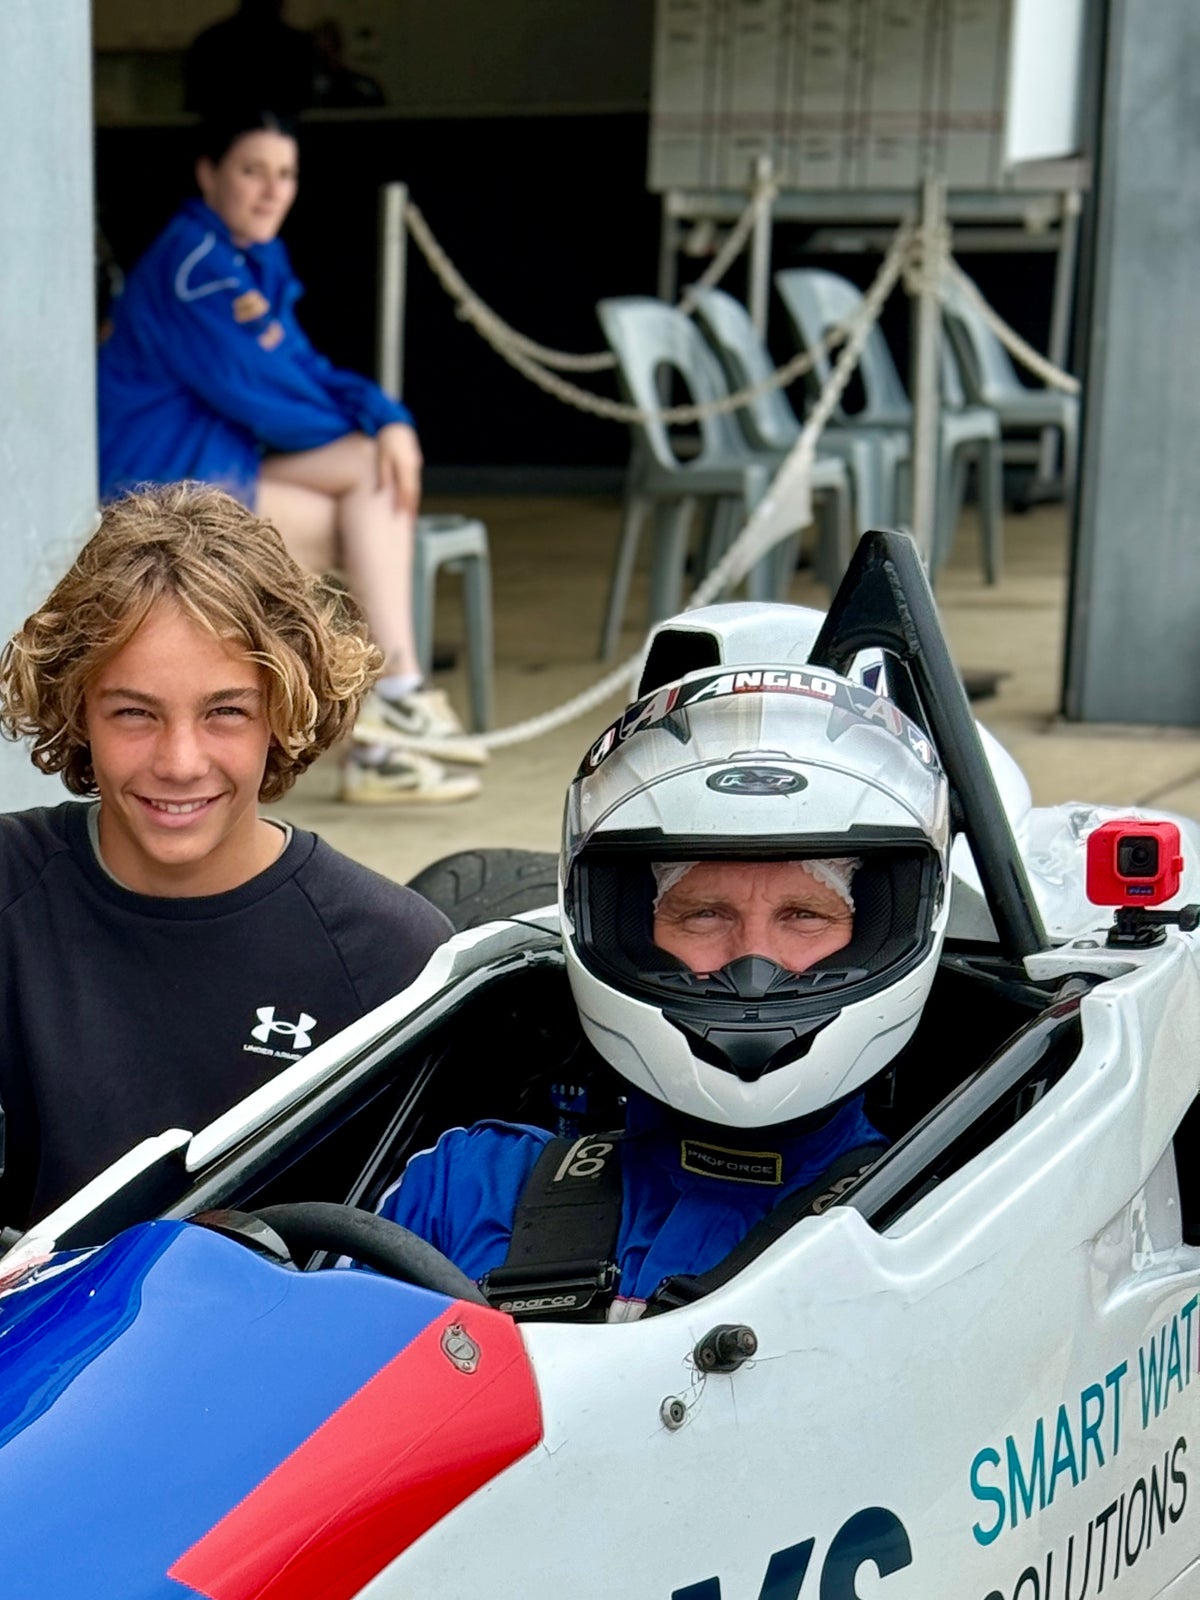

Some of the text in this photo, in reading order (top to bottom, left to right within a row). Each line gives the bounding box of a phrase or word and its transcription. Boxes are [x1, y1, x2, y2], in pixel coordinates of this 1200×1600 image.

[682, 670, 837, 706] ANGLO
[242, 1043, 275, 1056] UNDER
[687, 1149, 774, 1174] PROFORCE
[969, 1292, 1200, 1547] SMART WAT
